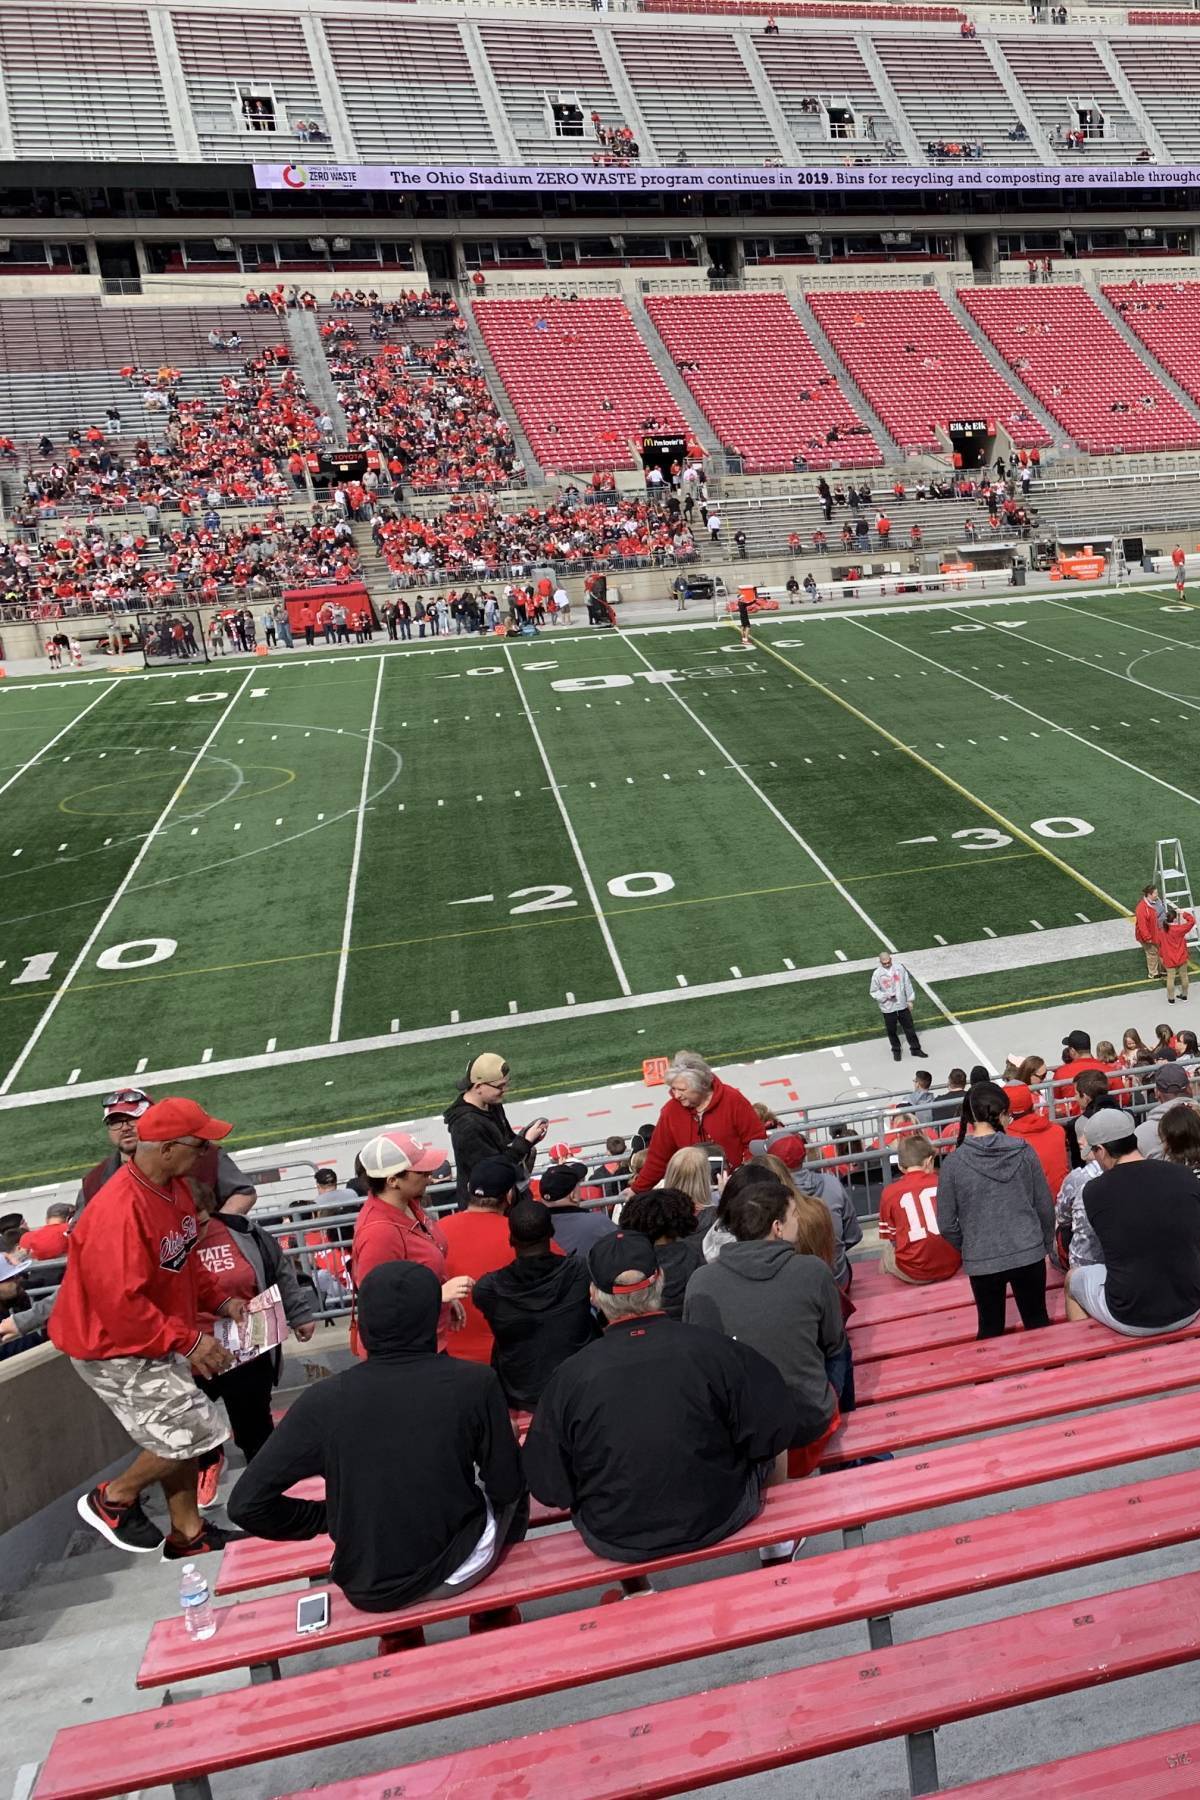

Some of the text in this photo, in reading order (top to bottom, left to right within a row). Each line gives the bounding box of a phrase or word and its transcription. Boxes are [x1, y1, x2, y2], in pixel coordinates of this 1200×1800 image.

[309, 172, 357, 181] ZERO WASTE
[390, 171, 421, 184] The
[428, 171, 464, 184] Ohio
[469, 171, 532, 184] Stadium
[536, 172, 578, 185] ZERO
[582, 172, 637, 185] WASTE
[641, 174, 703, 188] program
[707, 172, 776, 185] continues
[779, 172, 793, 185] in
[797, 172, 833, 185] 2019.
[836, 172, 865, 185] Bins
[869, 172, 887, 185] for
[891, 172, 953, 188] recycling
[958, 171, 981, 184] and
[985, 171, 1060, 187] composting
[1064, 174, 1085, 183] are
[1088, 170, 1145, 183] available
[950, 422, 964, 431] Elk
[972, 422, 986, 430] Elk
[951, 816, 1096, 850] 30
[507, 871, 676, 915] 20
